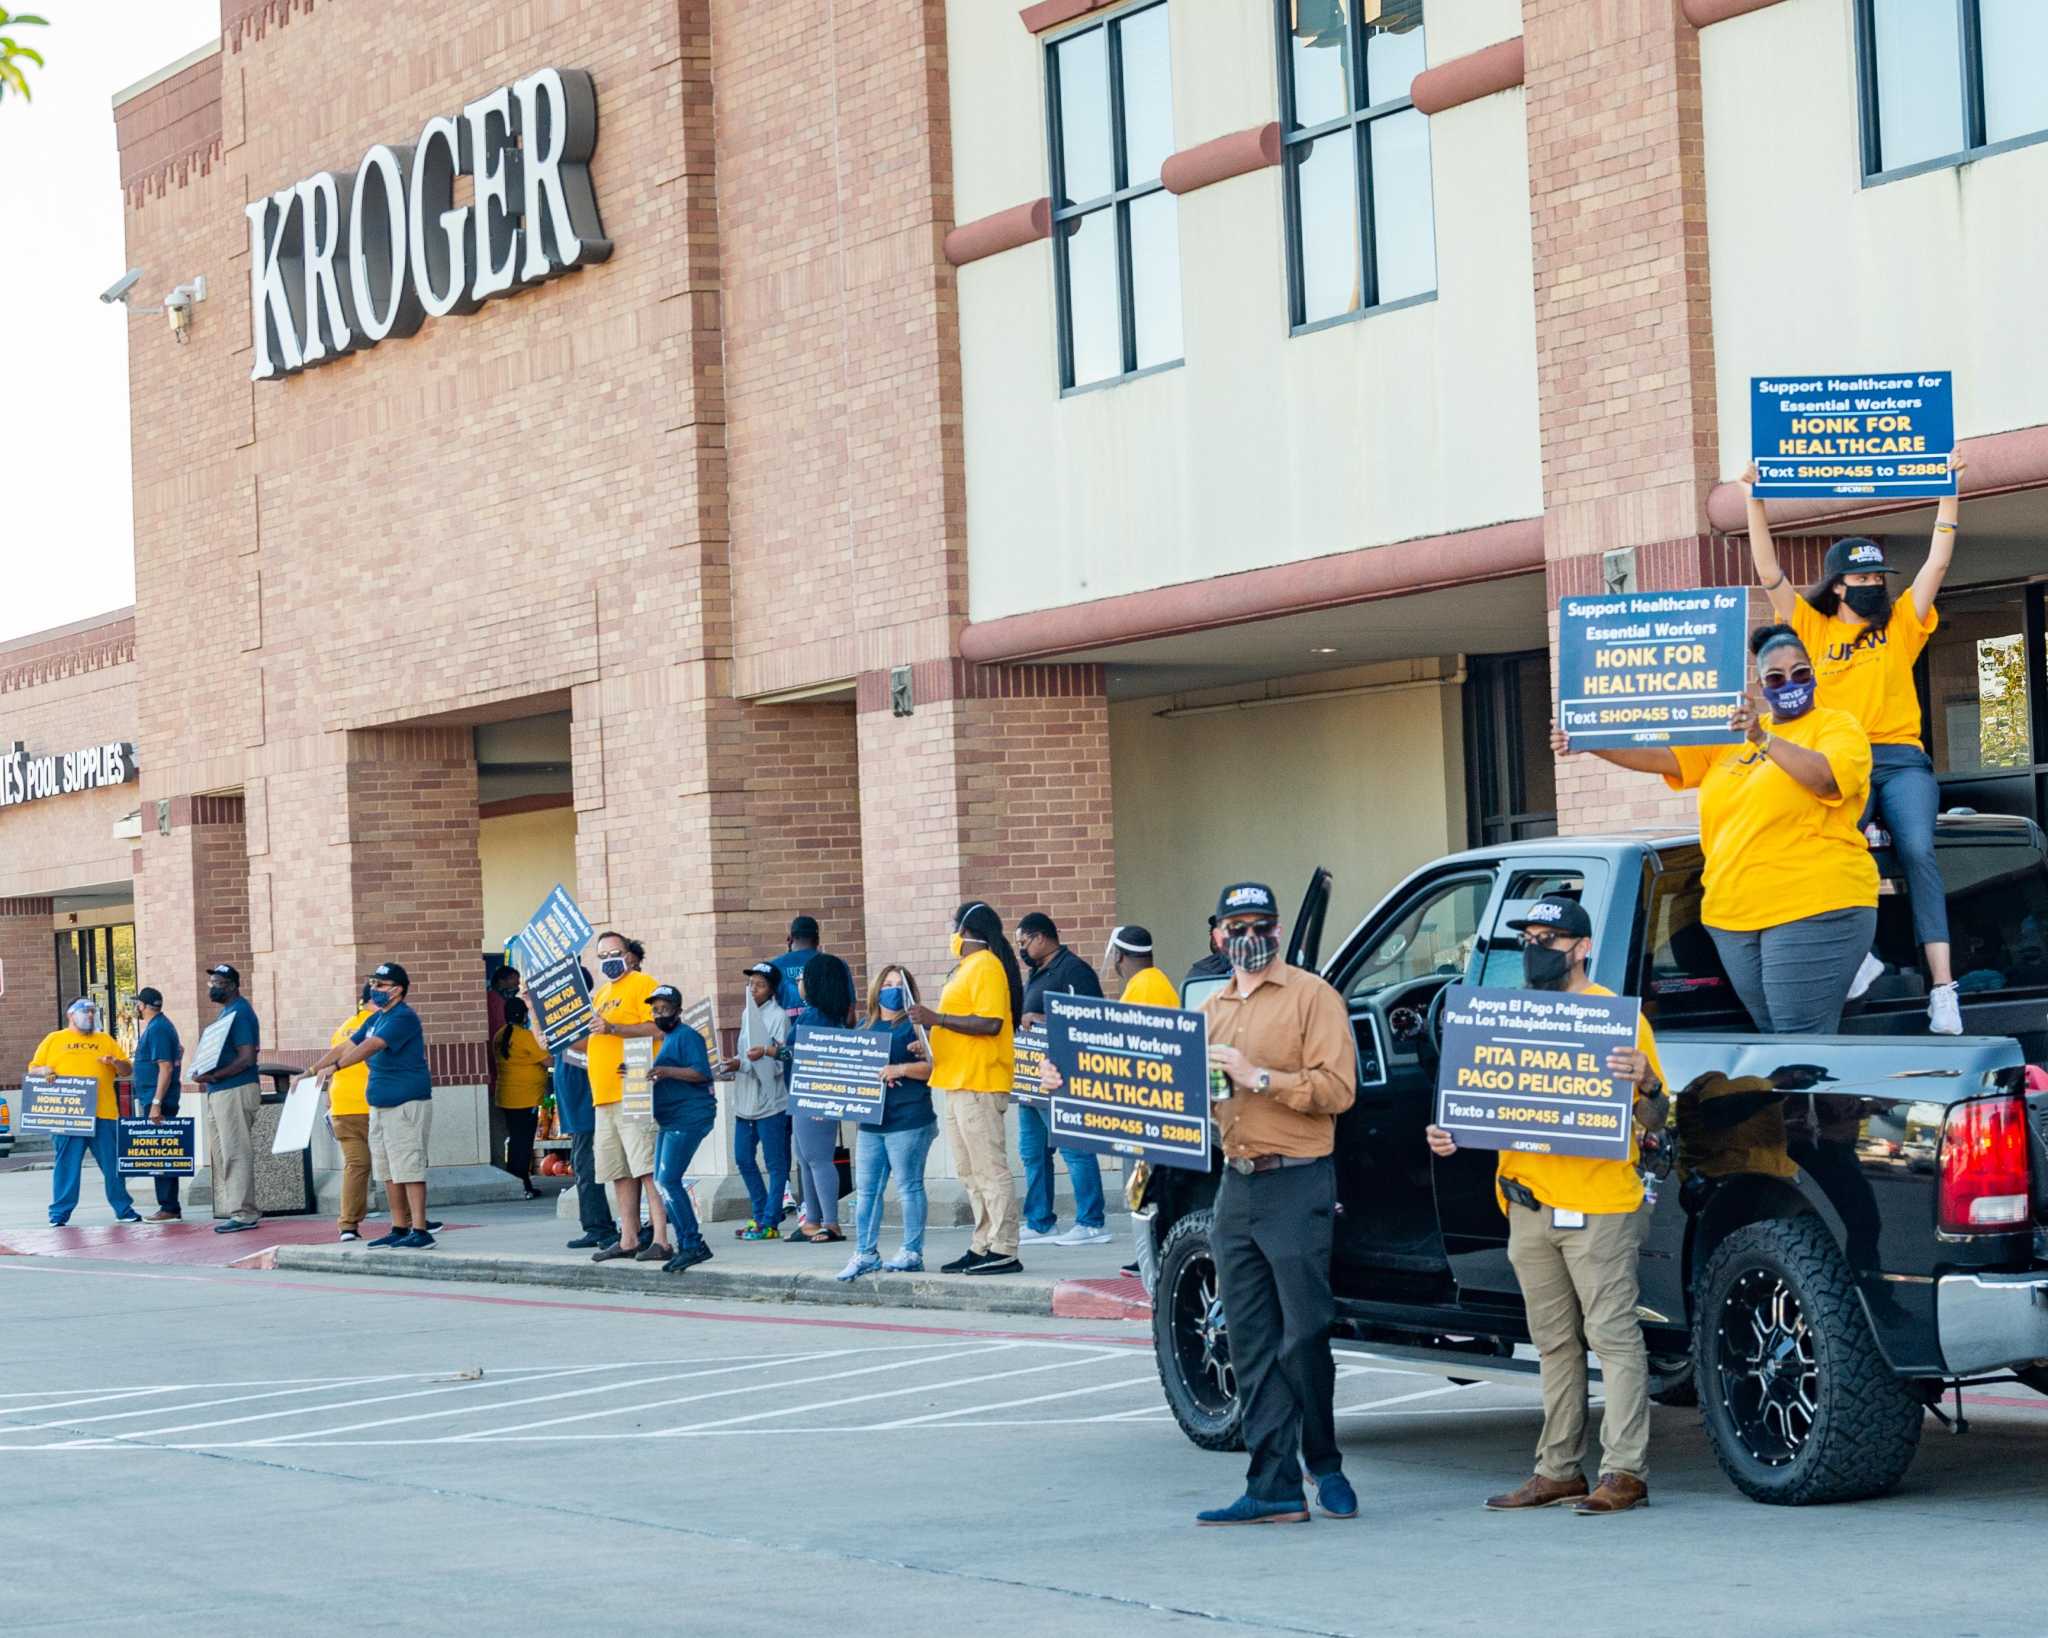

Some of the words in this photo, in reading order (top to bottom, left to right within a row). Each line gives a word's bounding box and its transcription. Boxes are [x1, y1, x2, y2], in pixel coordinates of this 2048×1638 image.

[245, 67, 583, 381] KROGER
[1759, 380, 1823, 395] Support
[1828, 377, 1913, 392] Healthcare
[1917, 376, 1942, 388] for
[1780, 399, 1850, 412] Essential
[1855, 397, 1922, 410] Workers
[1791, 418, 1859, 434] HONK
[1866, 416, 1912, 432] FOR
[1779, 436, 1926, 455] HEALTHCARE
[1759, 466, 1794, 478] Text
[1798, 465, 1873, 478] SHOP455
[1876, 465, 1894, 477] to
[1897, 463, 1947, 476] 52886
[1567, 601, 1627, 618] Support
[1630, 597, 1710, 613] Healthcare
[1713, 594, 1737, 608] for
[1586, 624, 1650, 640] Essential
[1655, 621, 1717, 637] Workers
[1595, 647, 1658, 668] HONK
[1664, 644, 1706, 665] FOR
[1584, 670, 1718, 695] HEALTHCARE
[1566, 711, 1597, 725] Text
[1600, 707, 1669, 723] SHOP455
[1672, 707, 1688, 720] to
[27, 756, 59, 800] POOL
[62, 742, 124, 793] SUPPLIES
[543, 993, 563, 1011] HONK
[561, 985, 577, 1000] FOR
[1468, 997, 1506, 1014] Apoya
[1509, 999, 1521, 1012] El
[1523, 1000, 1553, 1016] Pago
[1555, 1002, 1610, 1019] Peligroso
[544, 996, 584, 1026] HEALTHCARE
[1051, 999, 1102, 1020] Support
[1105, 1006, 1174, 1030] Healthcare
[1177, 1015, 1198, 1033] for
[1446, 1011, 1473, 1025] Para
[1475, 1013, 1496, 1026] Los
[1498, 1015, 1572, 1032] Trabajadores
[1574, 1020, 1633, 1037] Esenciales
[808, 1031, 834, 1042] Support
[834, 1034, 857, 1043] Hazard
[857, 1036, 870, 1046] Pay
[1068, 1026, 1124, 1049] Essential
[1127, 1034, 1182, 1056] Workers
[828, 1045, 838, 1054] for
[839, 1047, 861, 1057] Kroger
[1013, 1048, 1029, 1061] ONK
[1474, 1045, 1516, 1067] PITA
[1520, 1048, 1572, 1071] PARA
[1577, 1053, 1600, 1073] EL
[1077, 1051, 1133, 1078] HONK
[1136, 1059, 1174, 1084] FOR
[794, 1080, 810, 1090] Text
[847, 1086, 856, 1094] to
[1457, 1068, 1514, 1090] PAGO
[1518, 1071, 1613, 1098] PELIGROS
[36, 1095, 62, 1104] HONK
[63, 1096, 81, 1105] FOR
[1069, 1077, 1184, 1112] HEALTHCARE
[31, 1104, 66, 1114] HAZARD
[68, 1106, 86, 1115] PAY
[1448, 1102, 1484, 1119] Texto
[1486, 1108, 1495, 1119] a
[1497, 1106, 1560, 1124] SHOP455
[1562, 1112, 1574, 1125] al
[1577, 1113, 1618, 1129] 52886
[120, 1119, 146, 1127] Support
[128, 1128, 156, 1136] Essential
[157, 1128, 184, 1136] Workers
[1055, 1108, 1082, 1126] Text
[1083, 1113, 1144, 1135] SHOP455
[1145, 1122, 1160, 1137] to
[1161, 1124, 1201, 1143] 52886
[132, 1137, 159, 1146] HONK
[161, 1137, 179, 1146] FOR
[127, 1148, 184, 1157] HEALTHCARE
